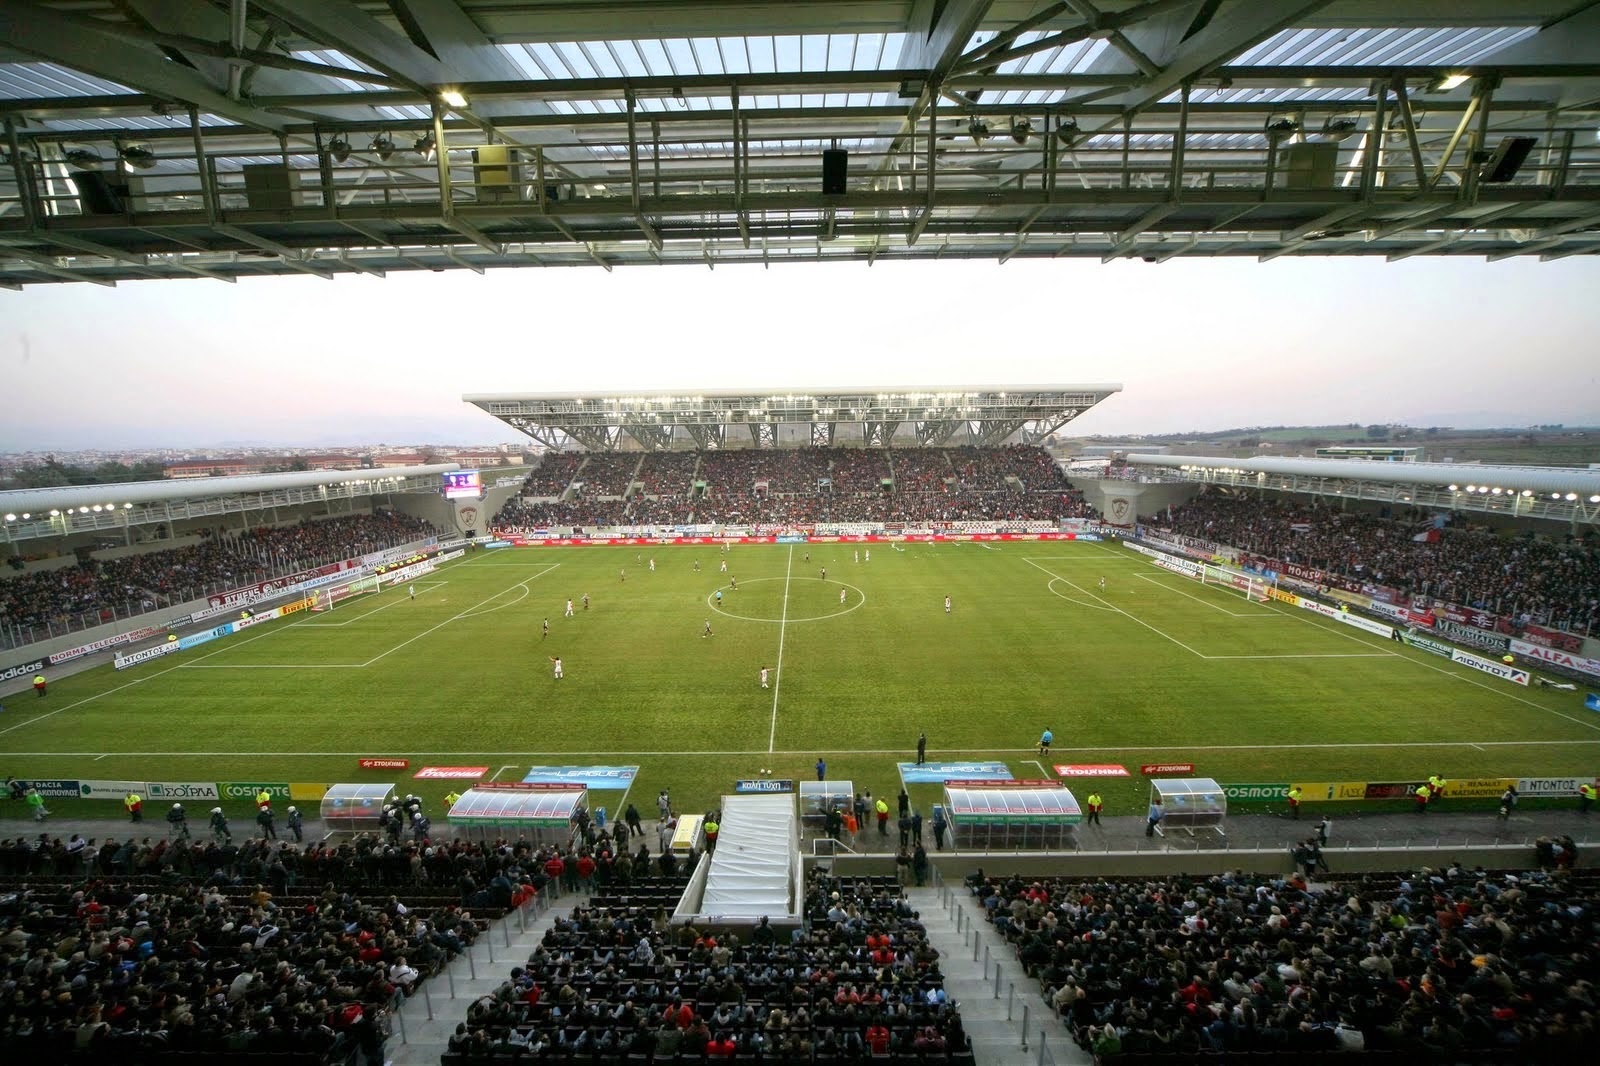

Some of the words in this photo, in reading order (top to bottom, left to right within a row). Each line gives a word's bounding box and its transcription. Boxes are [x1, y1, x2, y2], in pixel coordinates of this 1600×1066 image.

[1304, 602, 1335, 616] Driver
[1371, 603, 1396, 616] tsinas
[239, 612, 273, 628] Driver
[1435, 618, 1506, 648] MAXIMIADIS
[50, 646, 87, 664] NORMA
[88, 634, 129, 651] TELECOM
[1529, 648, 1574, 667] ALFA
[164, 784, 215, 797] ΣΟΥΡΛΑ
[225, 786, 289, 797] COSMOTE
[742, 781, 761, 790] καλή
[762, 781, 781, 790] τύχη
[1222, 787, 1290, 797] COSMOTE
[1529, 780, 1576, 791] ΝΤΟΝΤΟΣ
